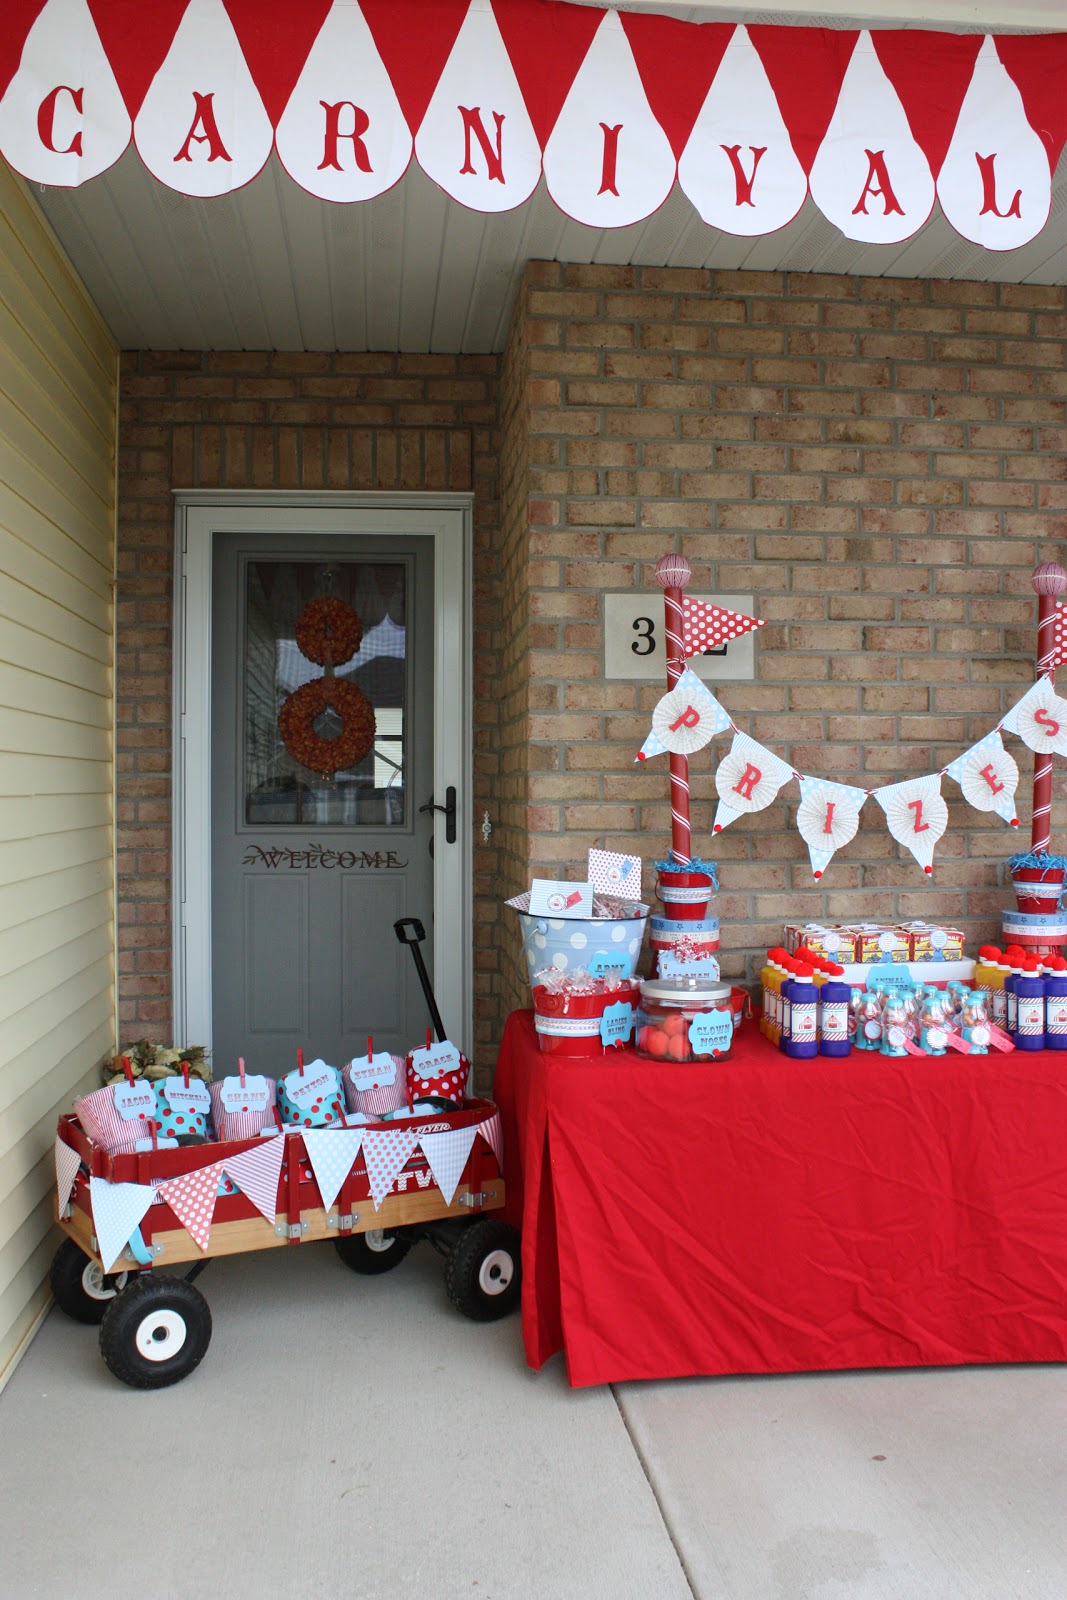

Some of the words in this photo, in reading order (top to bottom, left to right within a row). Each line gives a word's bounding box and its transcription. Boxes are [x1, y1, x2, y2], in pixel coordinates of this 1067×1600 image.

[249, 847, 408, 869] WELCOME
[606, 1017, 628, 1027] LADIES
[696, 1024, 730, 1036] CLOWN
[700, 1035, 728, 1047] NOSES
[418, 1054, 454, 1071] GRACE
[353, 1065, 392, 1080] ETHAN
[292, 1074, 329, 1100] PEYTON
[121, 1095, 152, 1109] JACOB
[169, 1092, 210, 1103] MITCHELL
[226, 1092, 266, 1103] SHANE
[413, 1122, 451, 1134] FLYER
